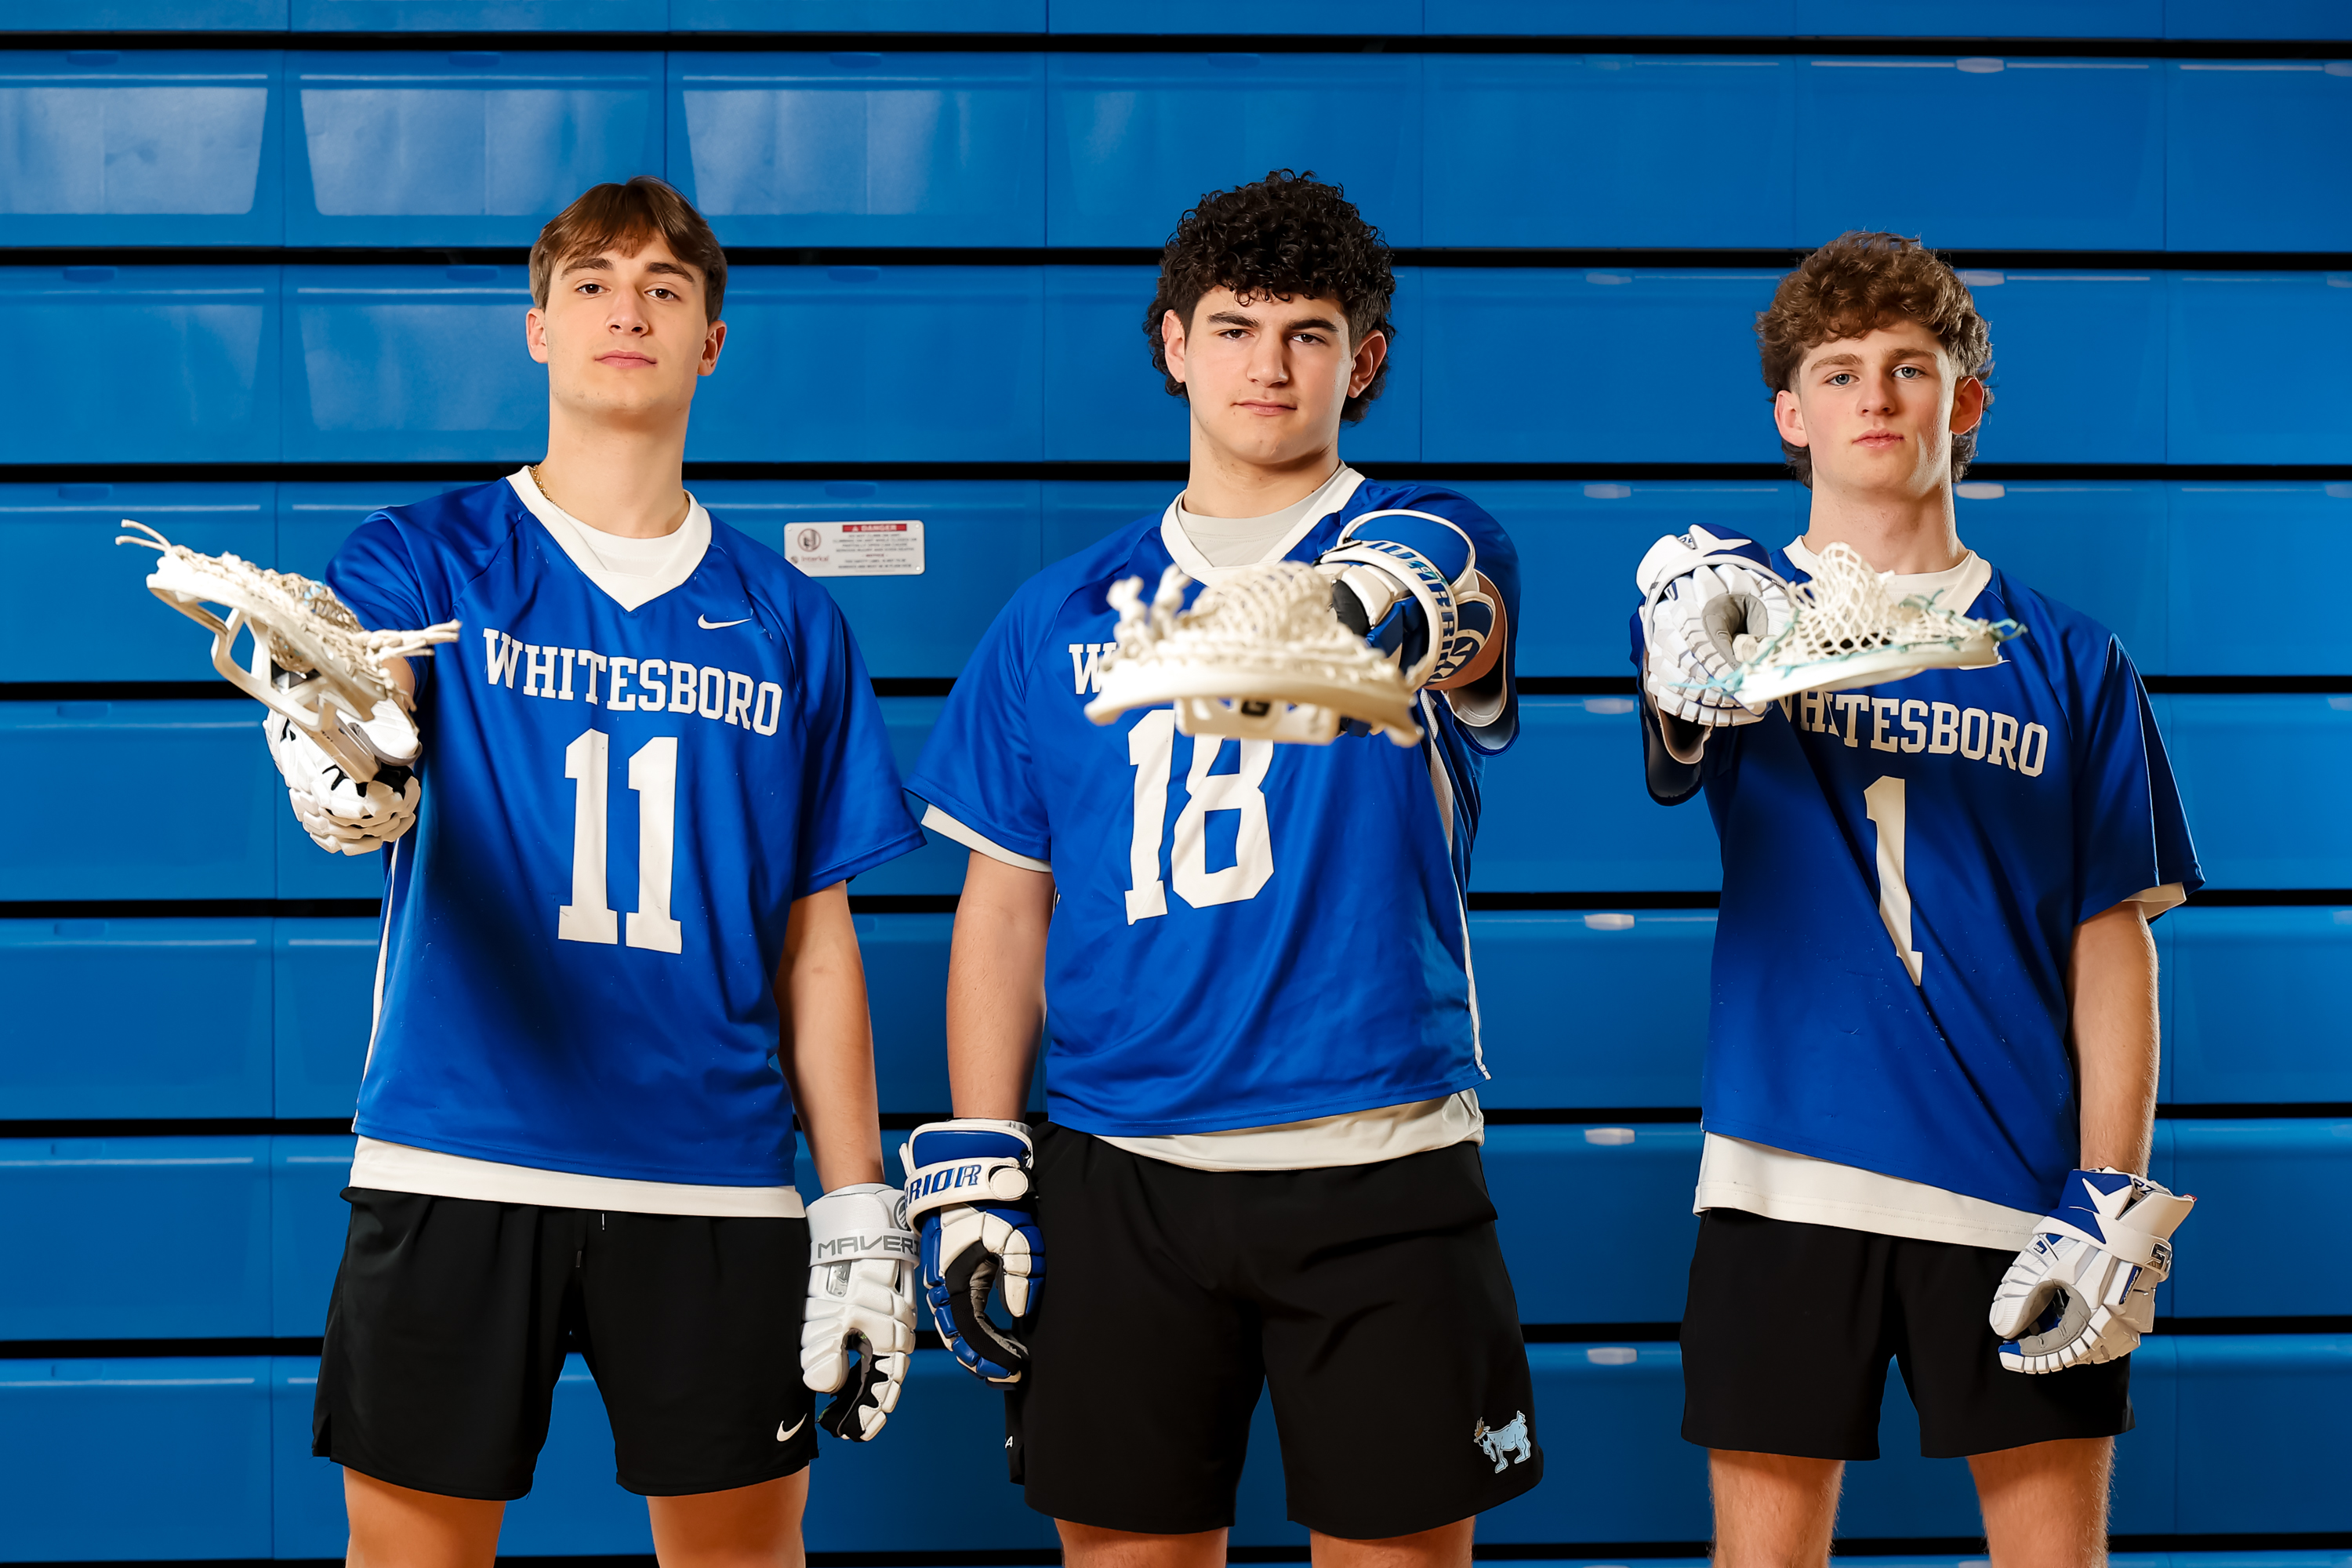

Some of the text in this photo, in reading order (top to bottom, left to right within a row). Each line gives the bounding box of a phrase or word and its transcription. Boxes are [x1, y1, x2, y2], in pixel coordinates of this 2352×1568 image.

[482, 627, 783, 737] WHITESBORO
[558, 728, 683, 955] 11
[1124, 709, 1275, 926] 18
[1863, 775, 1923, 987] 1
